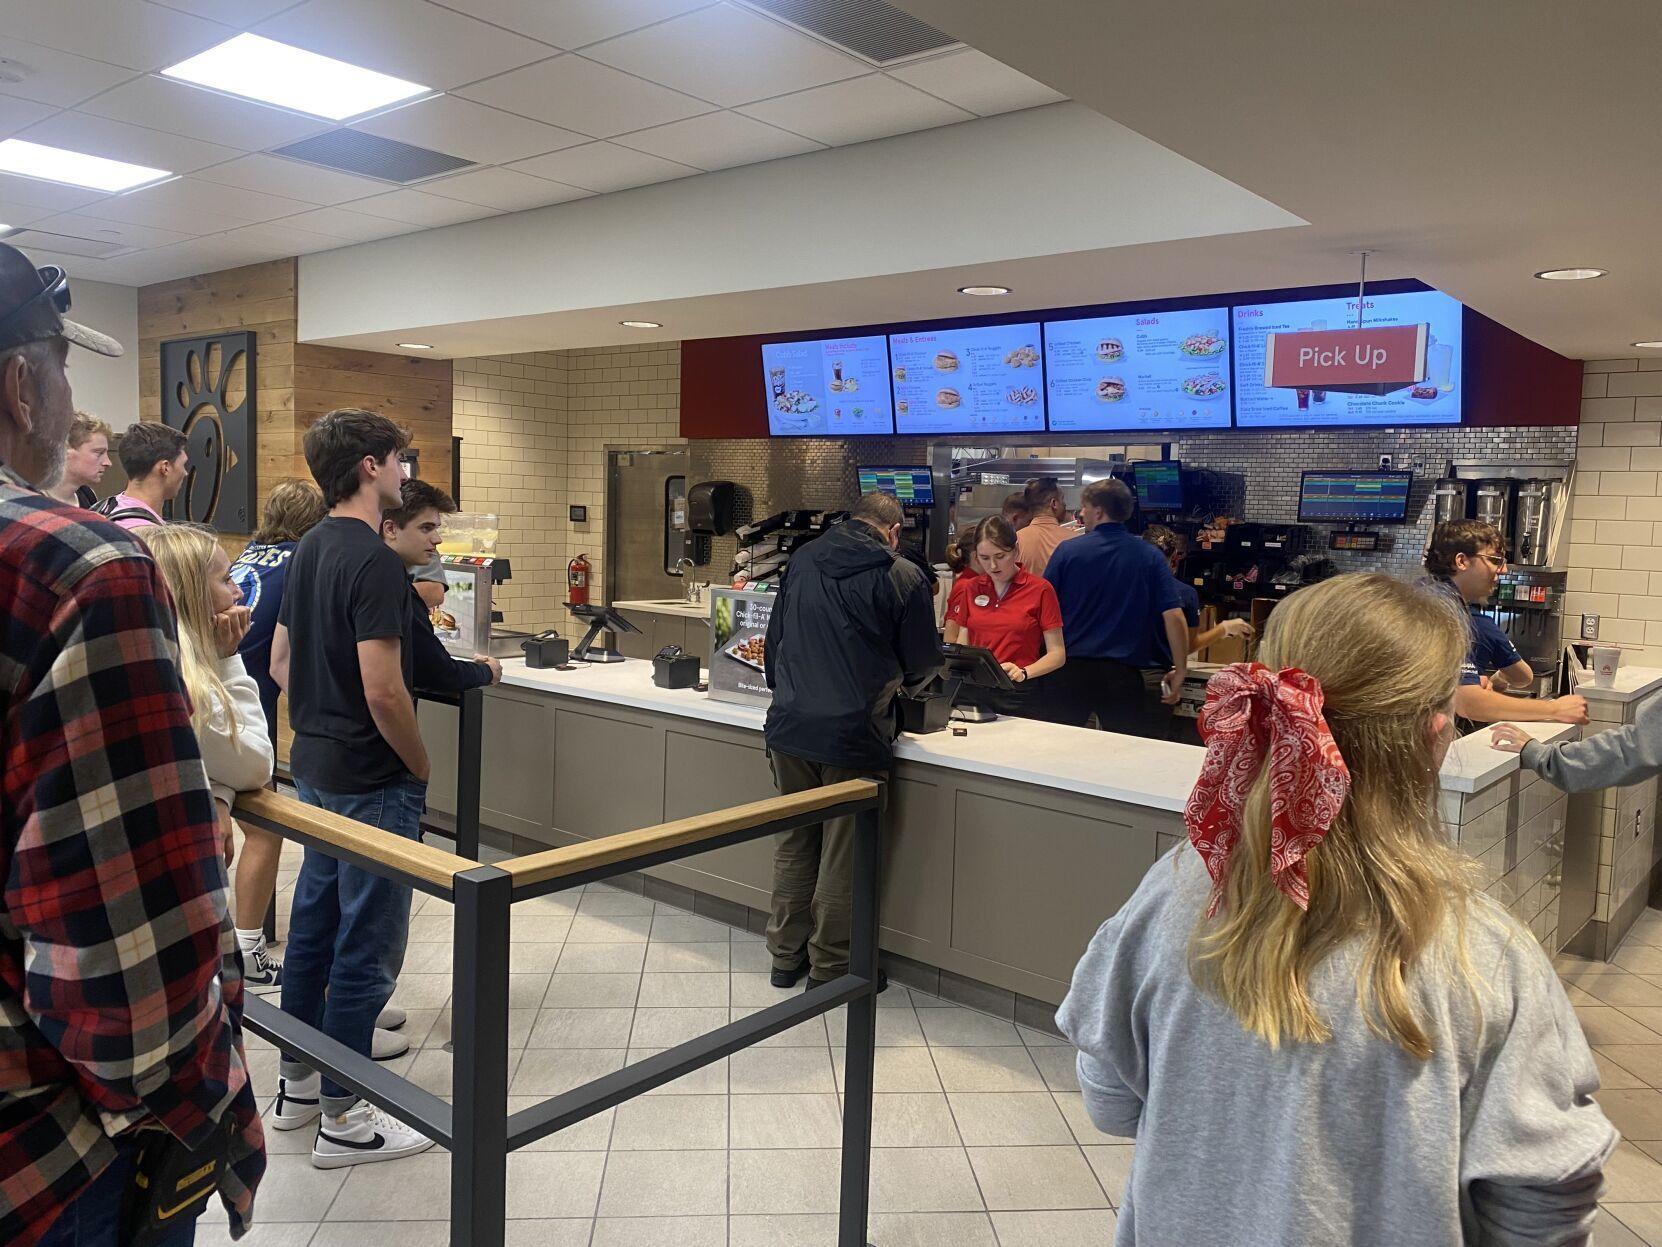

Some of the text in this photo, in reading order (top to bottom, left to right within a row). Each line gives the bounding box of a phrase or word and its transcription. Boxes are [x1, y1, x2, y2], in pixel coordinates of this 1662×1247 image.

[1237, 309, 1264, 319] Drinks
[1136, 317, 1159, 326] Salads
[1048, 343, 1054, 351] 5
[966, 348, 971, 357] 3
[1298, 344, 1388, 370] Pick Up
[968, 383, 972, 391] 4
[1050, 379, 1055, 388] 6
[749, 603, 773, 613] 30-coun
[740, 620, 759, 629] original
